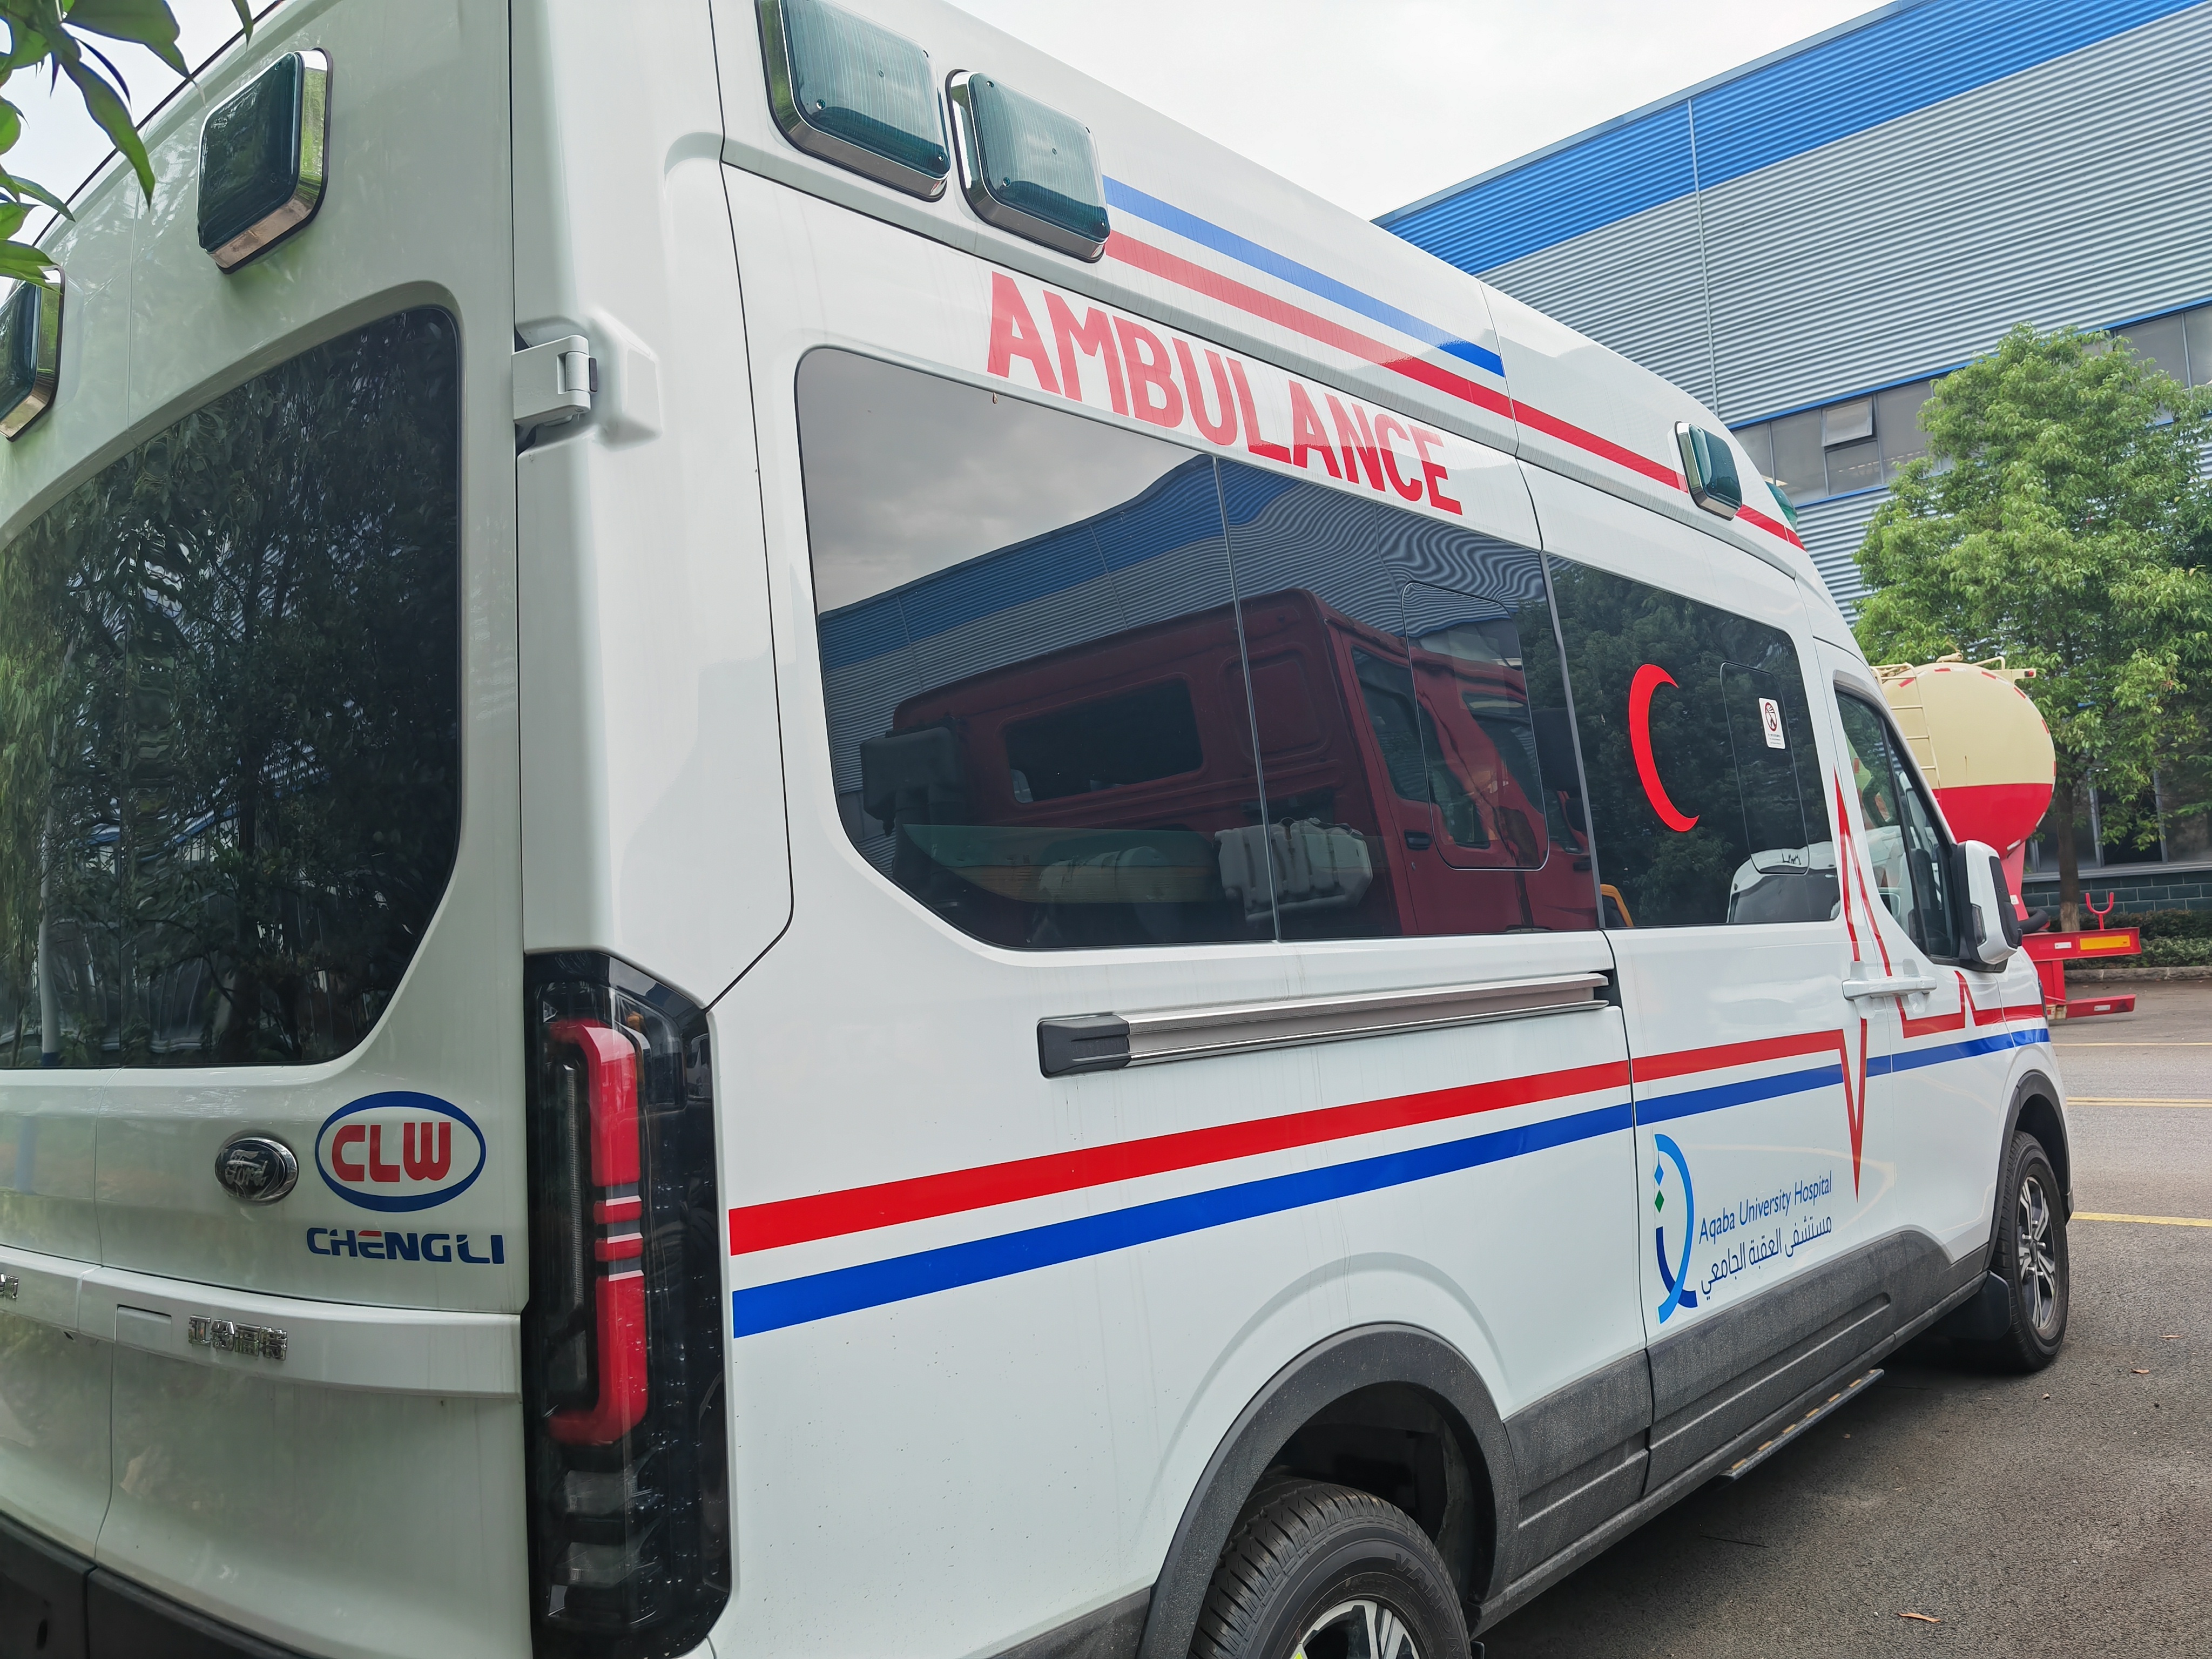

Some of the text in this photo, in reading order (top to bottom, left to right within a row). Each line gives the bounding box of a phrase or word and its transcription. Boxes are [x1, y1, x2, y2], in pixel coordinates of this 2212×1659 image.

[987, 271, 1462, 515] AMBULANCE
[225, 1149, 268, 1186] Ford
[332, 1122, 451, 1183] CLW
[1699, 1170, 1832, 1244] Aqaba University Hospital
[306, 1228, 504, 1264] CHENGLI
[1701, 1216, 1832, 1300] مستشفى العقبة الجامعي
